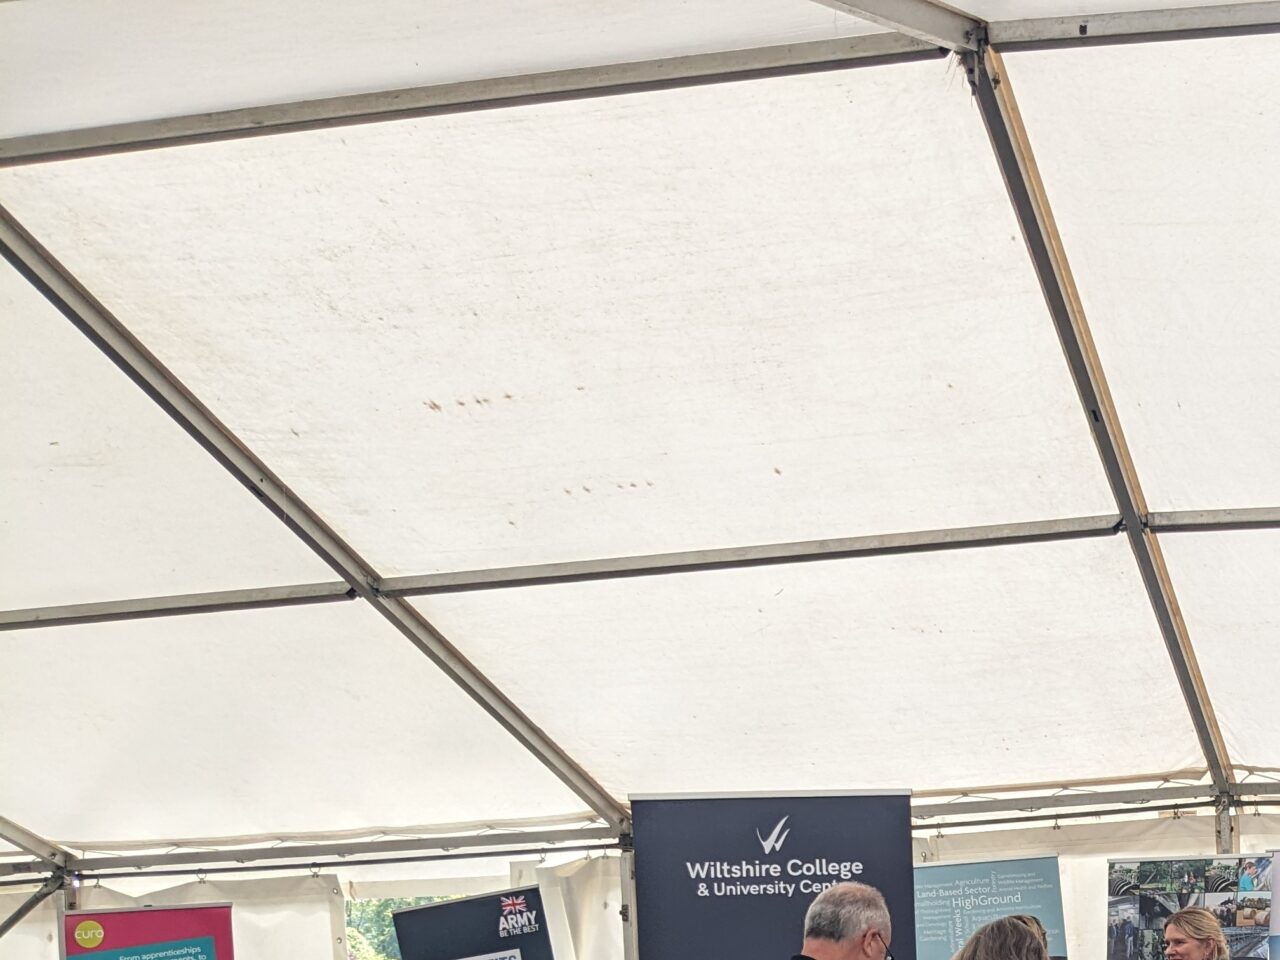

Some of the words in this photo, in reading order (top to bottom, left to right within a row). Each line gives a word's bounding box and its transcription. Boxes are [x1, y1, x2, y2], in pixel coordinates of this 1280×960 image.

[686, 860, 782, 879] Wiltshire
[786, 858, 863, 879] College
[697, 882, 710, 897] &
[713, 880, 796, 898] University
[917, 888, 963, 898] Land-Based
[964, 886, 991, 895] Sector
[952, 892, 1022, 910] HighGround
[499, 911, 537, 931] ARMY
[953, 909, 962, 937] Weeks
[75, 929, 104, 939] curo
[499, 930, 507, 938] BE
[509, 927, 522, 936] THE
[523, 924, 540, 934] BEST
